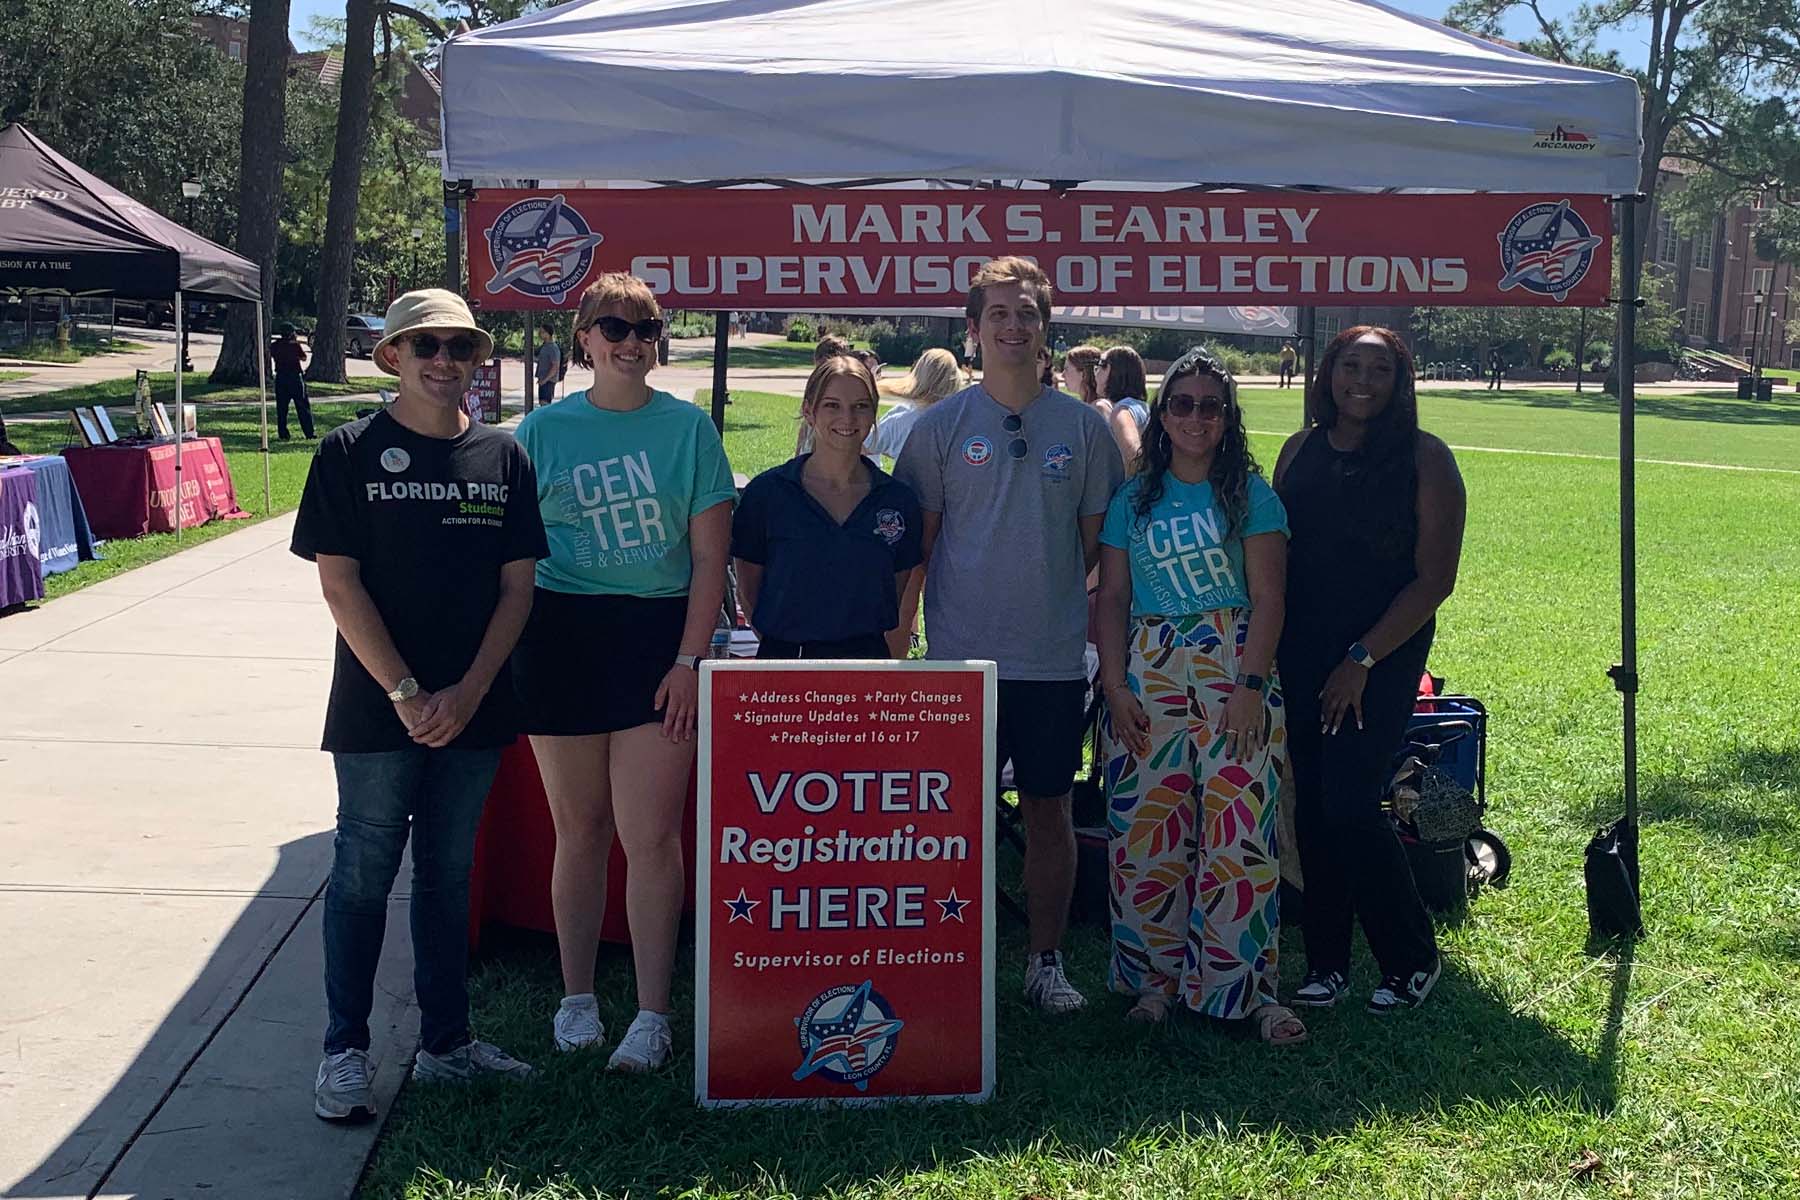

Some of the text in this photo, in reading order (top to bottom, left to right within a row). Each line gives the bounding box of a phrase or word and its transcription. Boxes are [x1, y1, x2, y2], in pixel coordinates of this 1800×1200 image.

[1533, 141, 1596, 151] ABCCANOPY
[511, 201, 548, 217] ELECTIONS
[792, 204, 1320, 243] MARK S. EARLEY
[25, 261, 38, 270] AT
[40, 261, 47, 270] A
[49, 261, 72, 270] TIME
[631, 255, 1468, 294] SUPERVISO OF ELECTIONS
[541, 285, 561, 294] LEON
[572, 450, 657, 508] CEN
[365, 482, 463, 502] FLORIDA
[441, 517, 467, 525] ACTION
[468, 517, 480, 525] FOR
[582, 497, 667, 551] TER
[1147, 507, 1221, 559] CEN
[598, 551, 608, 568] &
[1156, 547, 1237, 599] TER
[1180, 600, 1193, 616] &
[751, 690, 962, 705] Address Changes Party Changes
[744, 710, 971, 726] Signature Updates Name Changes
[781, 731, 920, 746] PreRegister at 16 or 17
[748, 772, 950, 812] VOTER
[720, 825, 967, 871] Registration
[771, 887, 925, 929] HERE
[733, 948, 965, 971] Supervisor of Elections
[800, 985, 856, 1049] SUPERVISOR OF ELECTIONS
[843, 1072, 863, 1080] LEON
